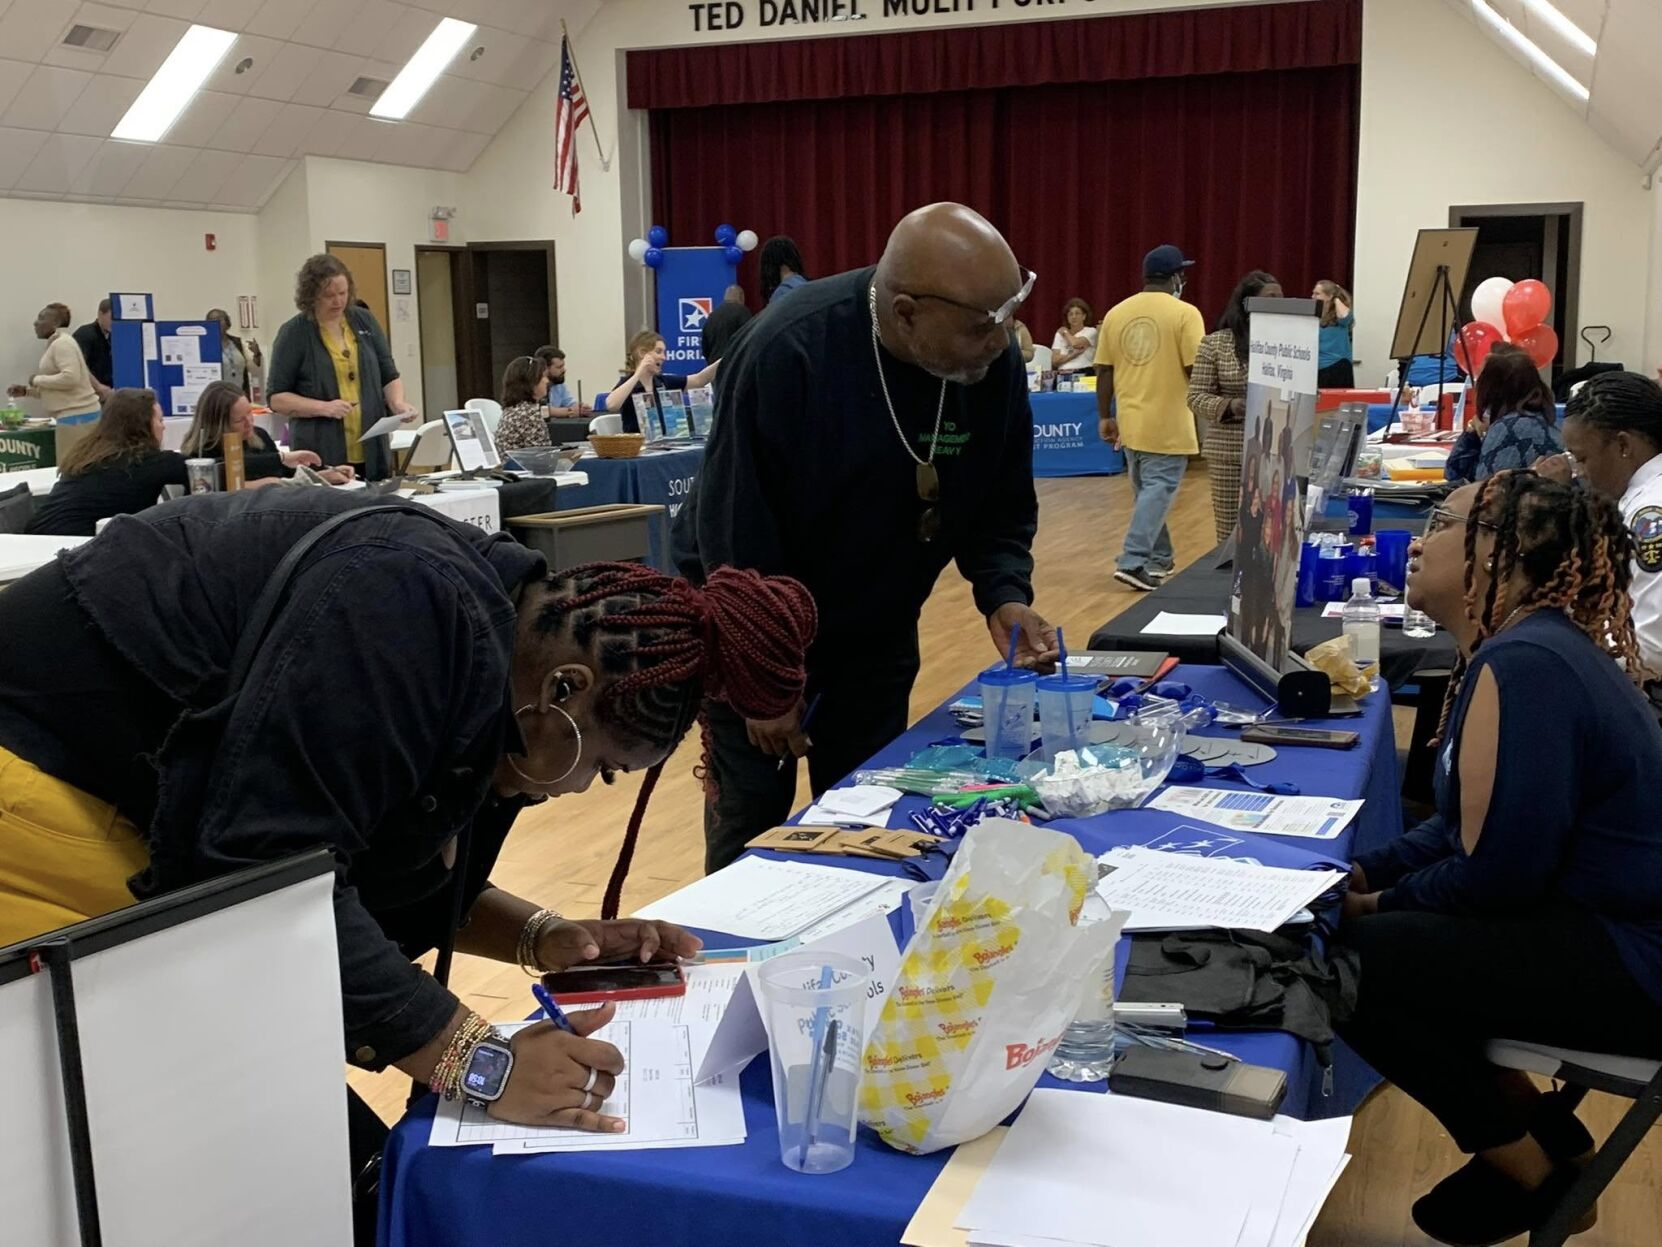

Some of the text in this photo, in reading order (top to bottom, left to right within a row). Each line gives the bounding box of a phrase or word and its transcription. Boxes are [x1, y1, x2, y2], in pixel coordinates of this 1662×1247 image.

[689, 2, 744, 32] TED
[759, 0, 867, 27] DANIEL
[677, 336, 703, 347] FIR
